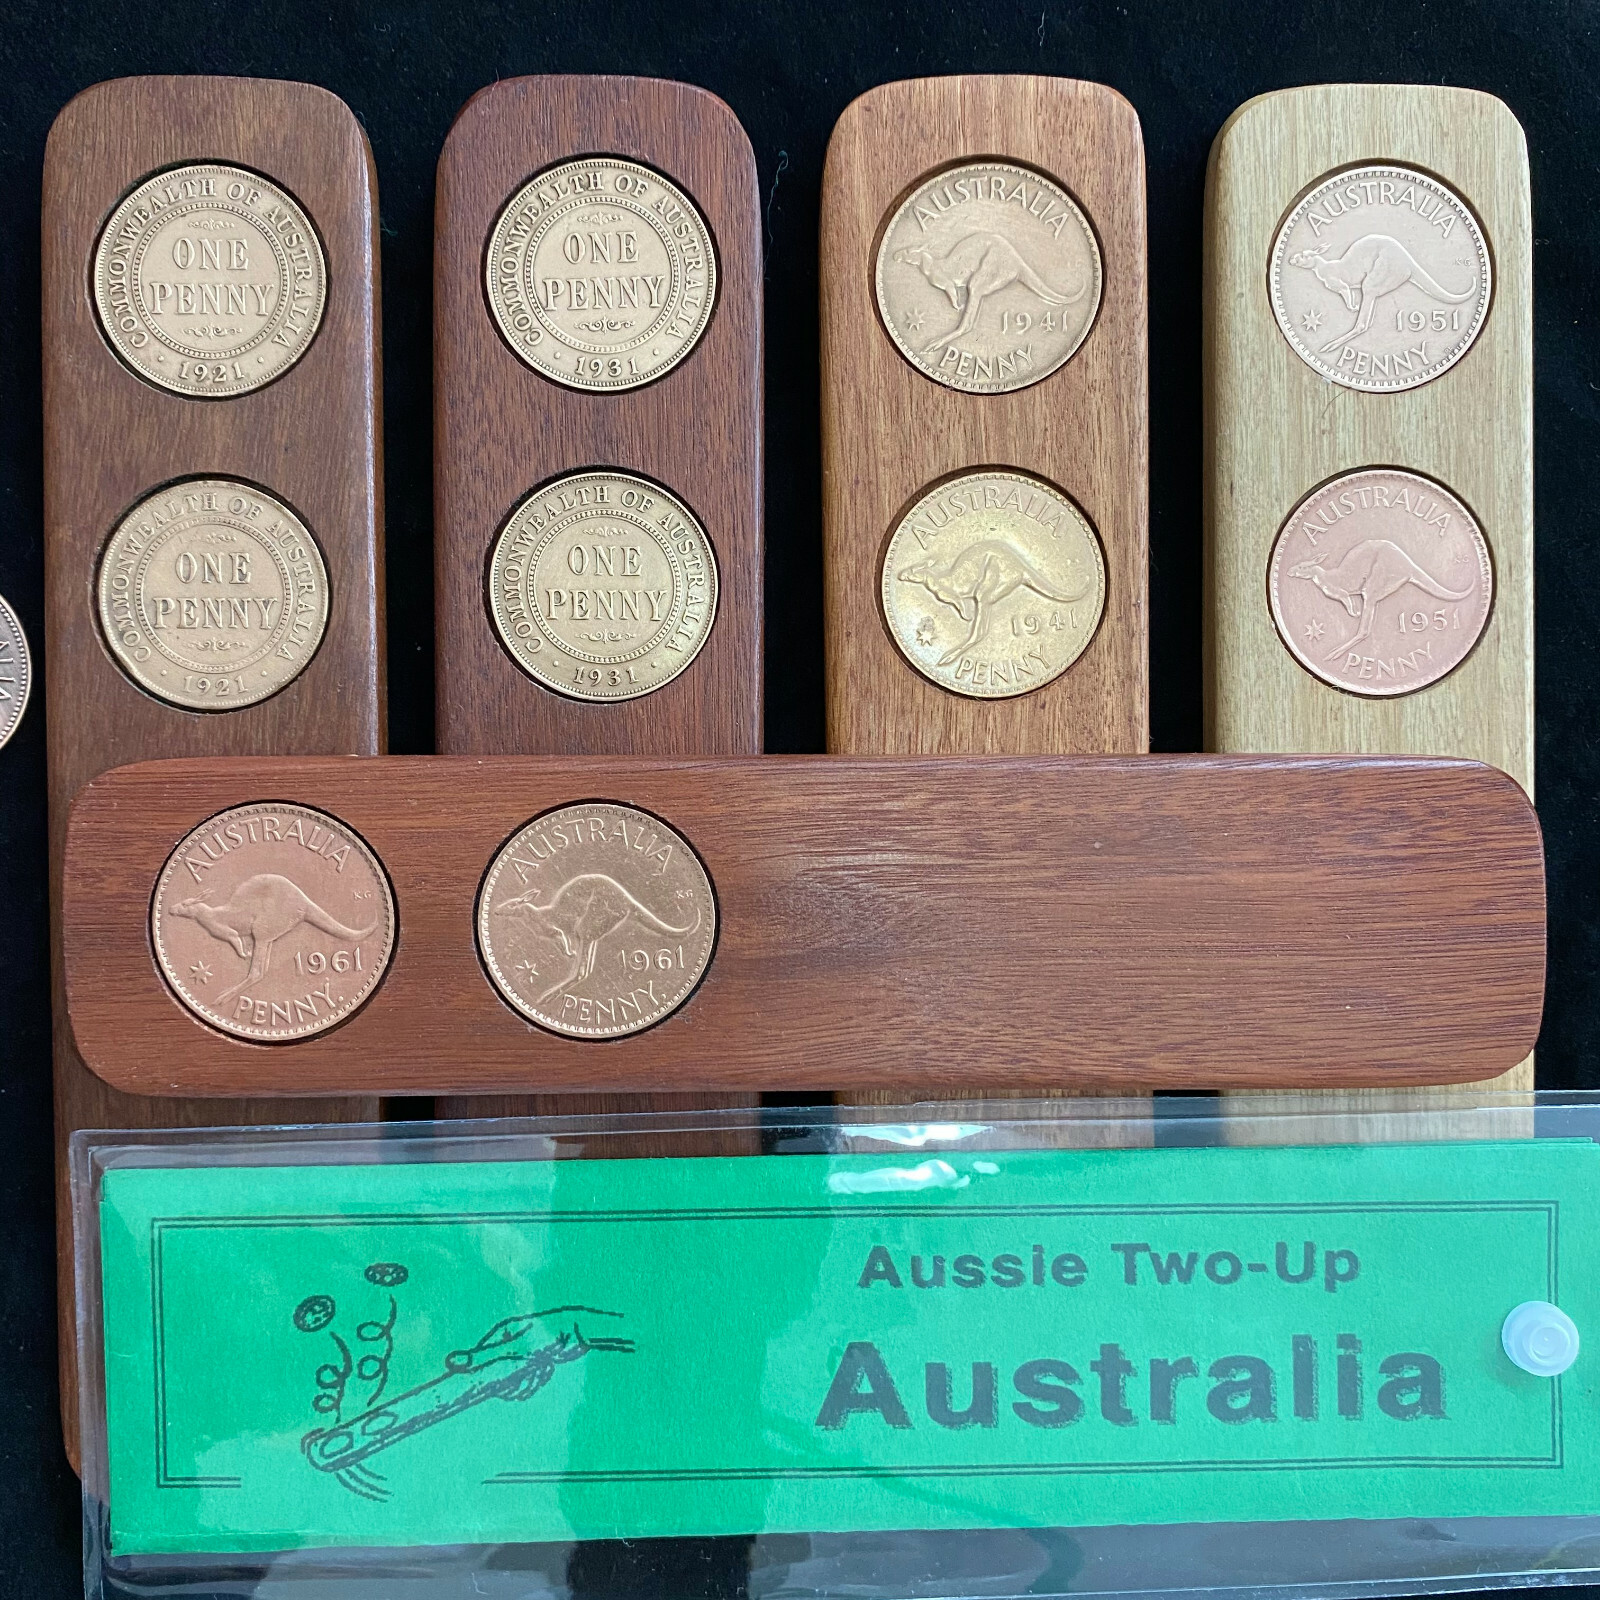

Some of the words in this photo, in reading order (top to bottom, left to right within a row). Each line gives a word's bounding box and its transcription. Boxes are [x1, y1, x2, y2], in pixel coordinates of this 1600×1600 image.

[914, 174, 1070, 239] AUSTRALIA
[1306, 181, 1459, 240] AUSTRALIA
[107, 176, 216, 349] COMMONWEALTH
[227, 182, 260, 205] OF
[267, 208, 312, 349] AUSTRALIA
[172, 236, 250, 270] ONE
[499, 174, 604, 347] COMMONWEALTH
[614, 175, 647, 197] OF
[653, 196, 703, 339] AUSTRALIA
[563, 231, 638, 264] ONE
[149, 283, 273, 315] PENNY
[542, 276, 665, 310] PENNY
[1001, 309, 1069, 335] 1941
[1395, 306, 1459, 331] 1951
[180, 361, 245, 382] 1921
[575, 355, 638, 377] 1931
[939, 344, 1034, 380] PENNY
[1336, 338, 1430, 375] PENNY
[911, 483, 1067, 550] AUSTRALIA
[1301, 486, 1453, 548] AUSTRALIA
[114, 493, 215, 662] COMMONWEALTH
[231, 495, 263, 518] OF
[271, 521, 315, 661] AUSTRALIA
[176, 551, 251, 585] ONE
[503, 487, 610, 656] COMMONWEALTH
[621, 490, 654, 512] OF
[659, 510, 705, 653] AUSTRALIA
[567, 544, 642, 577] ONE
[154, 597, 278, 630] PENNY
[546, 589, 669, 622] PENNY
[1398, 608, 1461, 635] 1951
[1011, 609, 1078, 637] 1941
[574, 665, 637, 684] 1931
[955, 644, 1051, 685] PENNY
[1344, 644, 1434, 679] PENNY
[184, 675, 246, 696] 1921
[183, 818, 353, 884] AUSTRALIA
[510, 817, 674, 884] AUSTRALIA
[294, 944, 364, 974] 1961
[619, 946, 686, 971] 1961
[857, 1245, 1088, 1288] Aussie
[1112, 1242, 1360, 1293] Two-Up
[815, 1333, 1450, 1431] Australia
